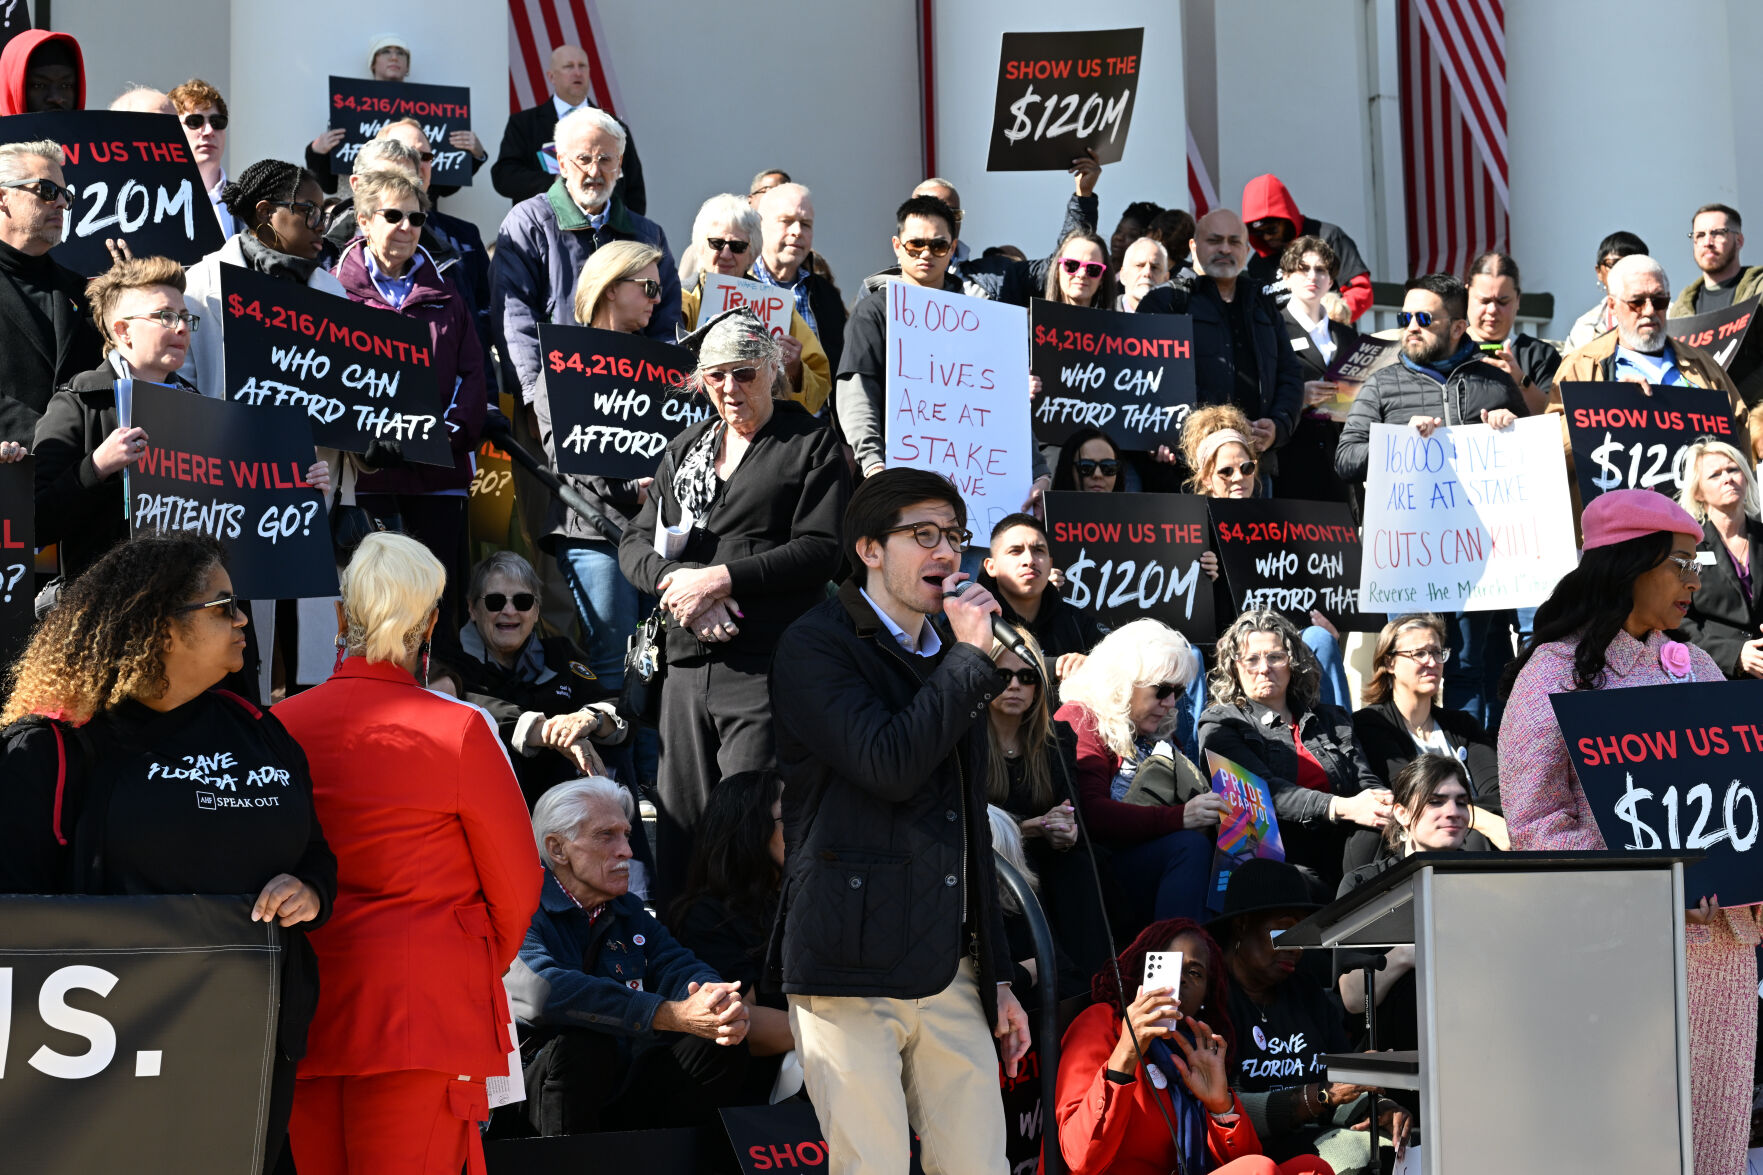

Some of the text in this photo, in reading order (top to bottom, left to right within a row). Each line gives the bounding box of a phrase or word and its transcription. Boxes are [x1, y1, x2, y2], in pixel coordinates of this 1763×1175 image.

[1005, 55, 1137, 79] SHOW US THE
[333, 93, 468, 118] $4,216/MONTH
[1003, 83, 1130, 146] $120M
[423, 123, 447, 143] AN
[90, 141, 129, 163] US
[132, 141, 188, 163] THE
[61, 178, 195, 243] 120M
[716, 284, 784, 322] TRUMP
[228, 293, 430, 367] $4,216/MONTH
[1035, 324, 1190, 359] $4,216/MONTH
[1688, 313, 1750, 348] US THE
[1348, 351, 1375, 366] NO
[1359, 342, 1382, 355] WE
[271, 345, 400, 398] WHO CAN
[548, 350, 704, 394] $4,216/MO
[1061, 362, 1163, 396] WHO CAN
[353, 404, 437, 440] THAT?
[594, 388, 711, 428] WHO CAN
[896, 388, 992, 428] ARE AT
[1035, 397, 1190, 433] AFFORD THAT?
[1574, 408, 1732, 435] SHOW US THE
[562, 424, 668, 459] AFFORD
[893, 434, 1008, 476] STAKE
[1385, 433, 1445, 475] 16,000
[137, 445, 317, 489] WHERE WILL
[1590, 431, 1689, 493] $120
[1387, 474, 1528, 511] ARE AT STAKE
[135, 493, 319, 545] PATIENTS GO?
[1054, 521, 1203, 544] SHOW US THE
[1218, 520, 1358, 544] $4,216/MONTH
[1255, 550, 1343, 581] WHO CAN
[1374, 528, 1432, 569] CUTS
[1440, 527, 1483, 565] CAN
[1062, 547, 1201, 620] $120M
[1242, 585, 1361, 615] AFFORD THAT
[1369, 581, 1417, 604] Reverse
[1425, 582, 1449, 602] the
[1578, 724, 1763, 766] SHOW US TH
[217, 797, 253, 808] SPEAK
[255, 796, 279, 807] OUT
[1219, 767, 1266, 810] PRIDE
[1229, 791, 1270, 825] CAPITOL
[1614, 771, 1760, 852] $120
[1241, 1057, 1305, 1078] FLORIDA
